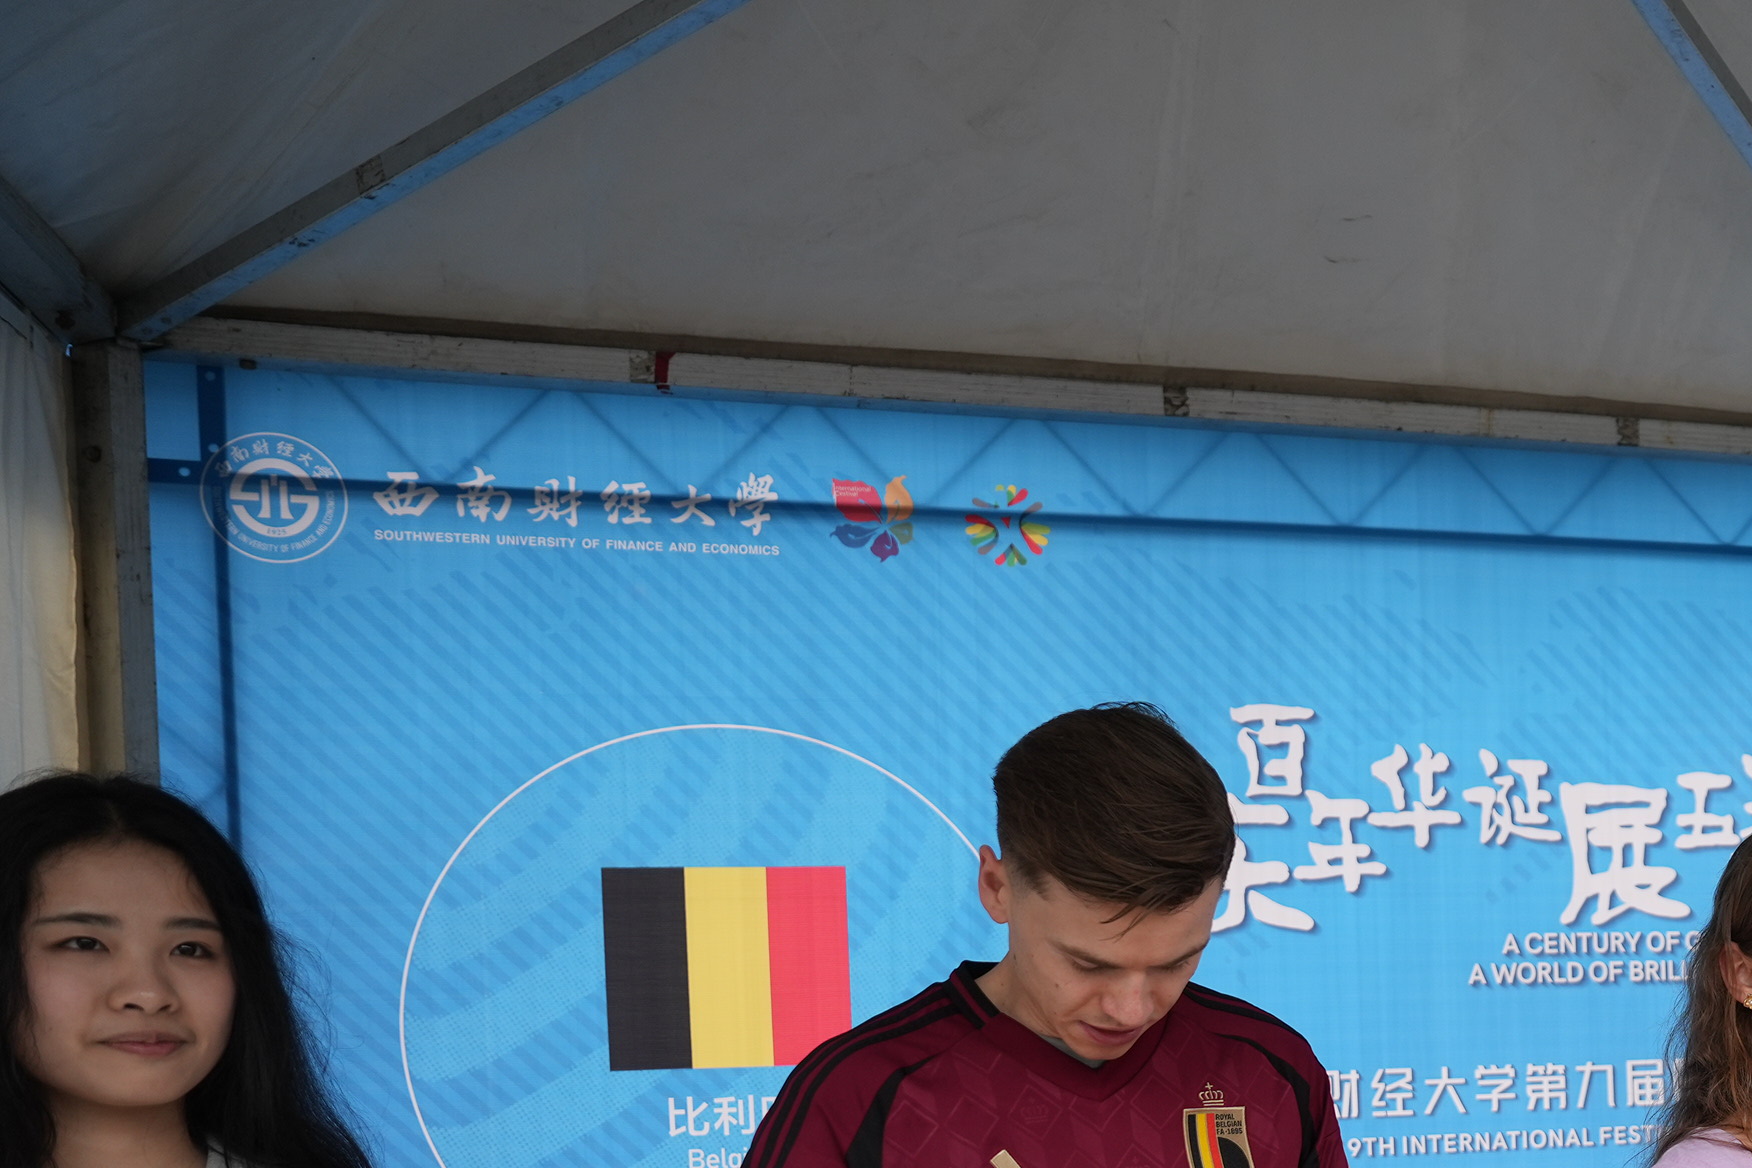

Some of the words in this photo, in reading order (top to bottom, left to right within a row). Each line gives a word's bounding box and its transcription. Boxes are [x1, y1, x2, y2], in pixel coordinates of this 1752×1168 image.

[373, 529, 491, 545] SOUTHWESTERN
[496, 533, 576, 549] UNIVERSITY
[581, 537, 600, 549] OF
[605, 538, 664, 552] FINANCE
[668, 542, 697, 553] AND
[701, 542, 780, 556] ECONOMICS
[1501, 932, 1520, 954] A
[1524, 930, 1642, 955] CENTURY
[1646, 930, 1681, 952] OF
[1468, 962, 1487, 985] A
[1491, 960, 1584, 984] WORLD
[1588, 960, 1624, 983] OF
[1629, 958, 1690, 983] BRILL
[1328, 1057, 1684, 1120] 财经大学第九届
[1215, 1113, 1235, 1121] ROYAL
[1215, 1120, 1242, 1128] BELGIAN
[1348, 1136, 1396, 1159] 9TH
[1402, 1126, 1595, 1156] INTERNATIONAL
[1600, 1122, 1664, 1147] FEST
